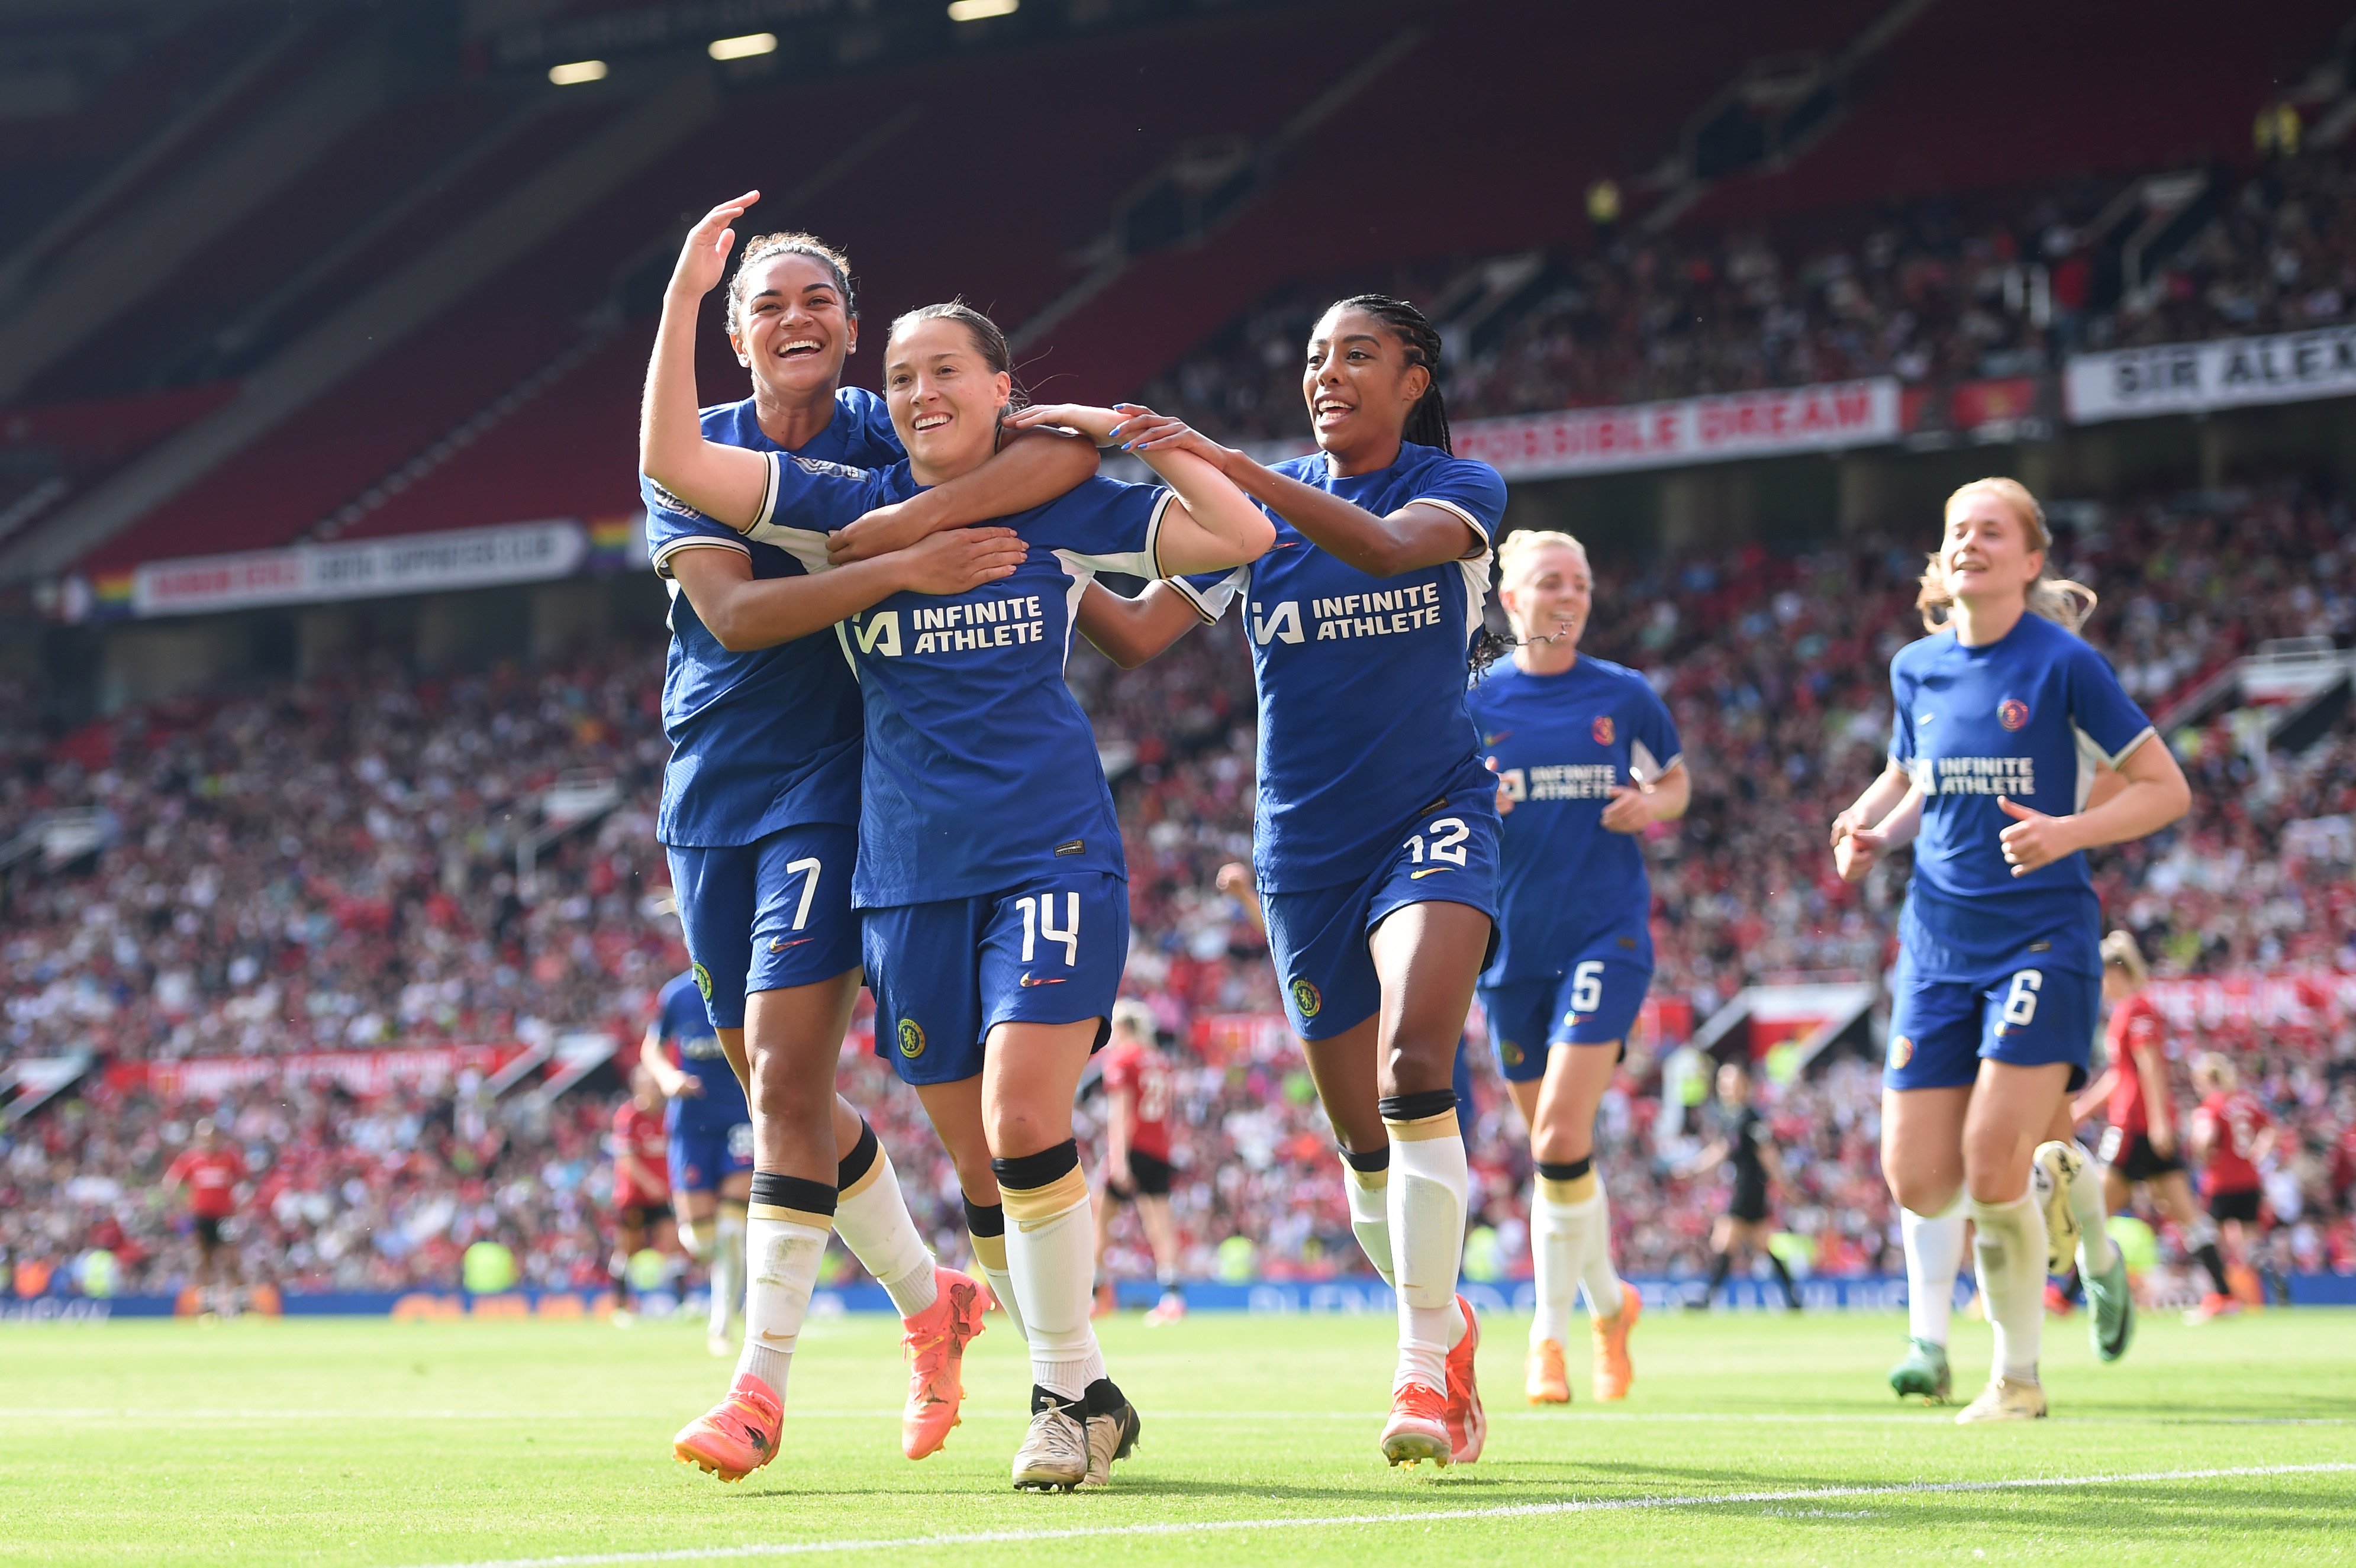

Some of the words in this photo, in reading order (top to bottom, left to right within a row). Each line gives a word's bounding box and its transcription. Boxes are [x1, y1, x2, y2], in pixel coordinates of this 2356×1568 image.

[2114, 356, 2197, 395] SIR
[1696, 389, 1870, 444] DREAM
[913, 596, 1042, 630] INFINITE
[1312, 582, 1439, 618] INFINITE
[914, 621, 1043, 654] ATHLETE
[1317, 605, 1440, 640] ATHLETE
[1529, 764, 1617, 782] INFINITE
[1938, 757, 2033, 776] INFINITE
[1939, 776, 2035, 795] ATHLETE
[1403, 818, 1469, 867] 12
[787, 857, 821, 930] 7
[1016, 892, 1079, 967] 14
[1571, 960, 1605, 1012] 5
[2003, 969, 2042, 1026] 6
